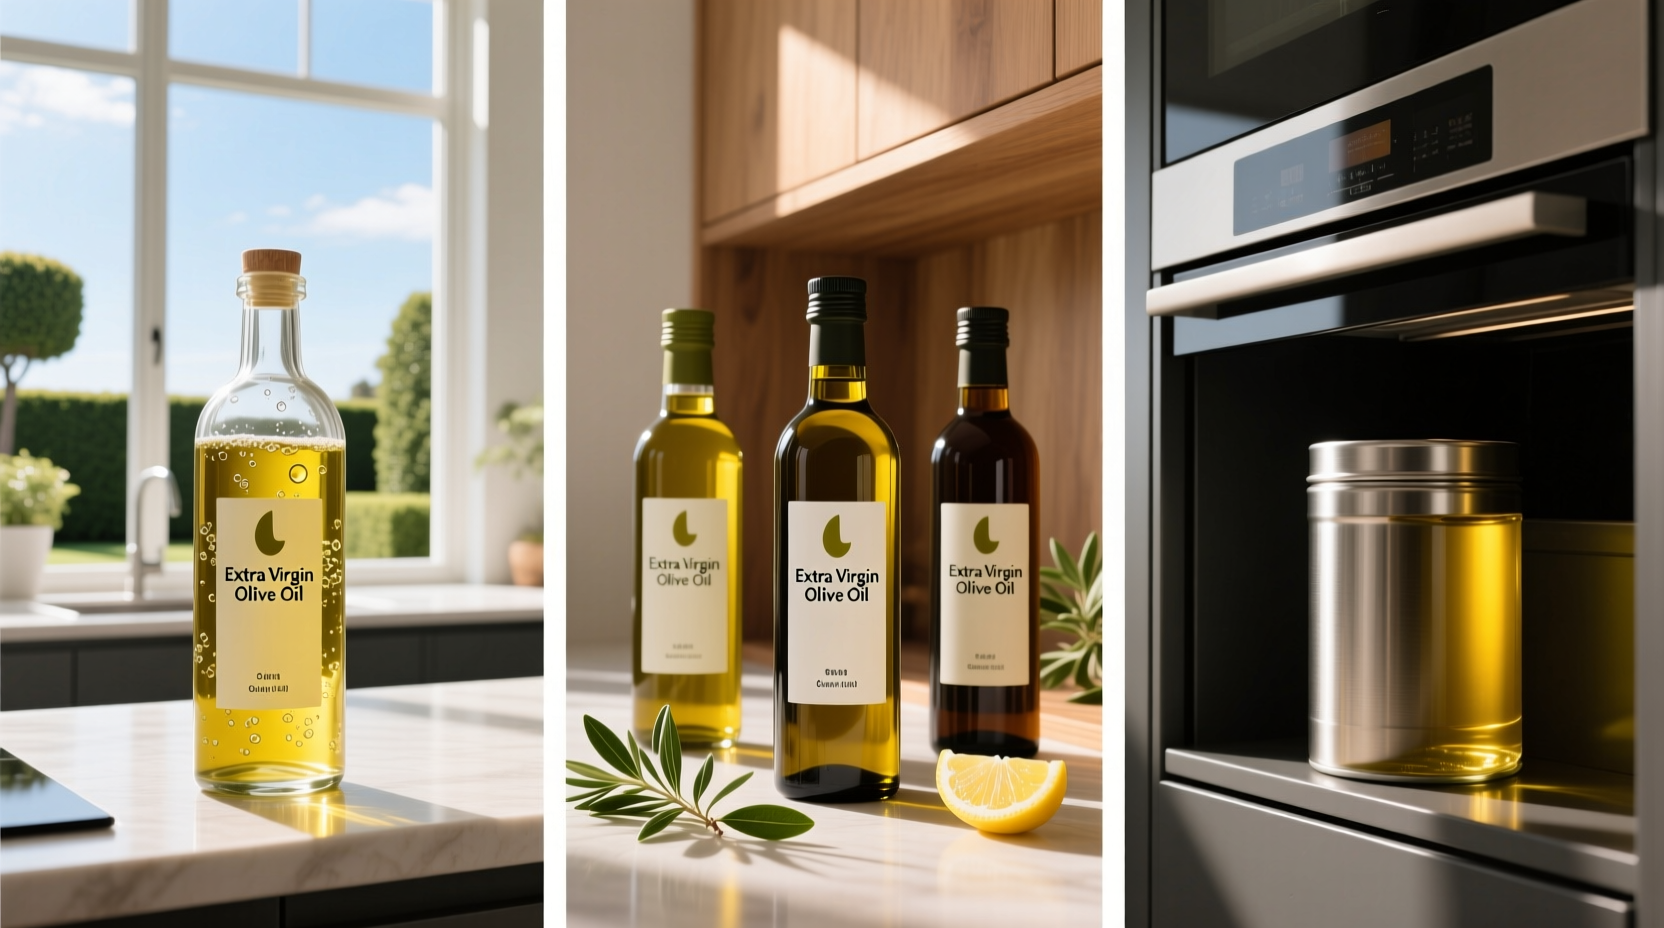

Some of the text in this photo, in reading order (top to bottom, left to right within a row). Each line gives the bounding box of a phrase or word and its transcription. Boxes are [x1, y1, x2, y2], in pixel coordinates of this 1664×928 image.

[649, 556, 720, 574] Extra Virgin
[949, 564, 1023, 581] Extra Virgin
[225, 566, 314, 586] Extra Virgin
[657, 573, 712, 586] Olive Oil
[795, 568, 879, 587] Extra Virgin
[234, 585, 303, 602] Olive Oil
[804, 586, 869, 602] Olive Oil
[956, 580, 1015, 595] Olive Oil
